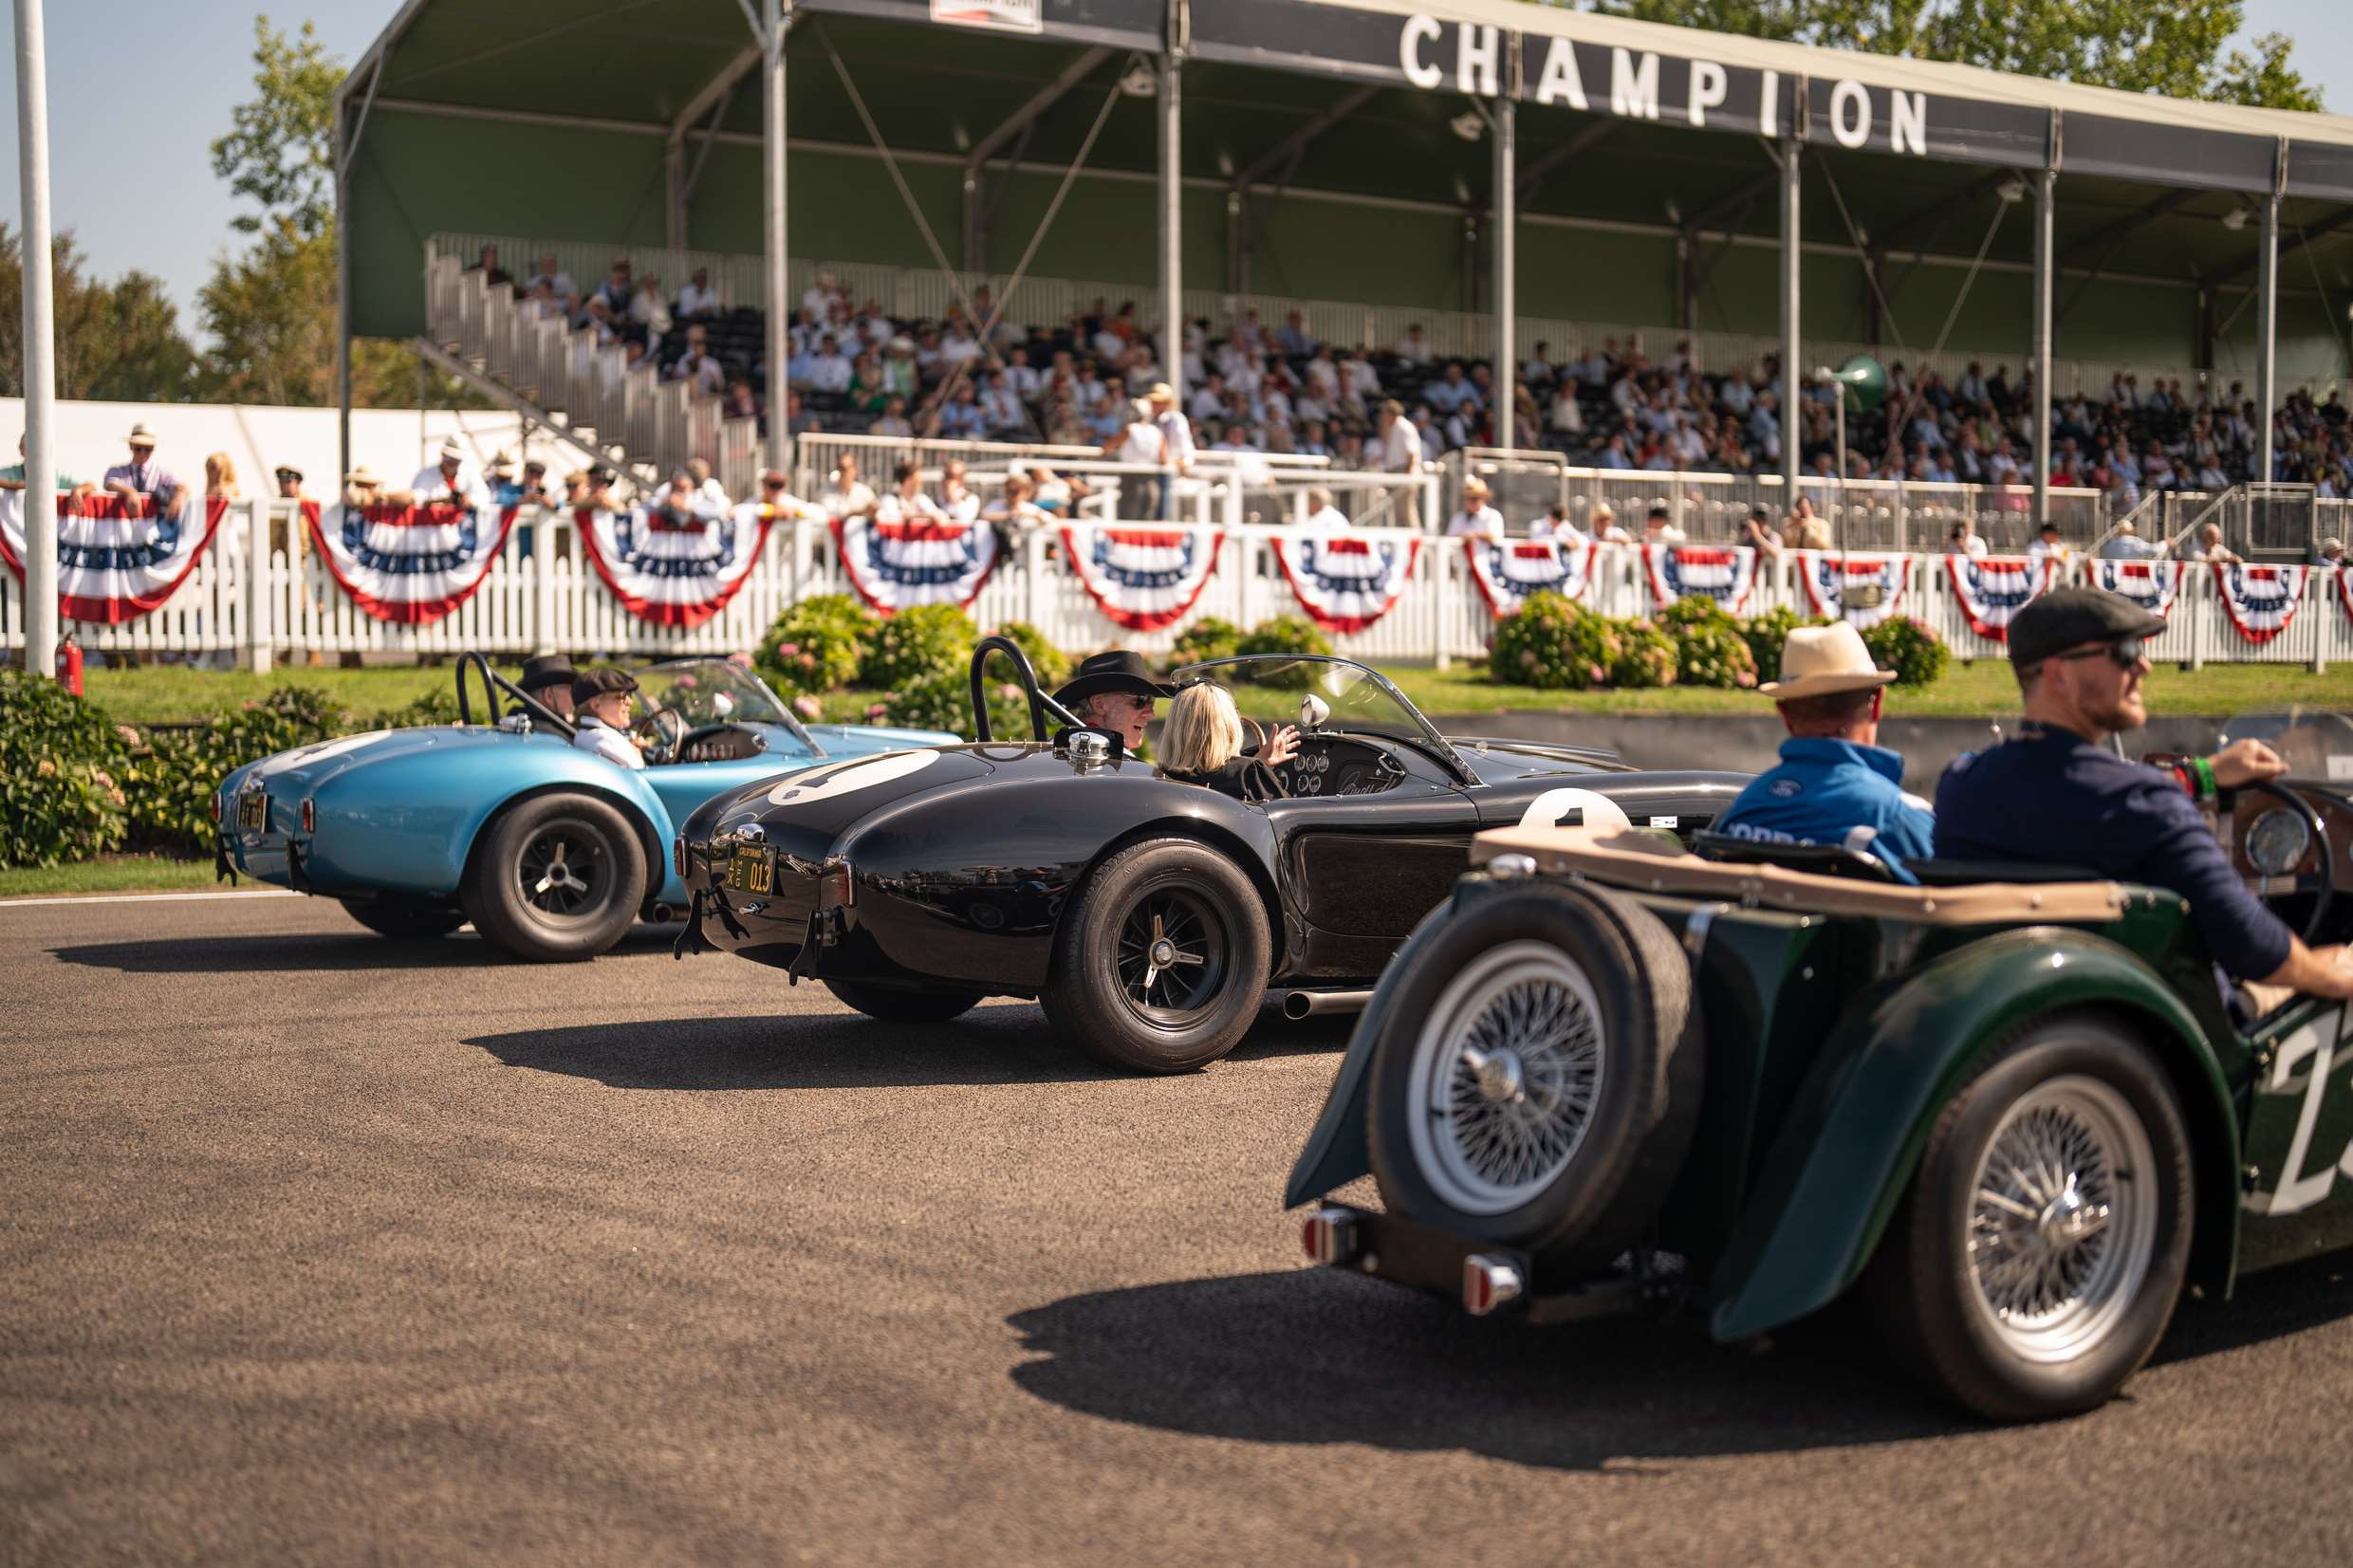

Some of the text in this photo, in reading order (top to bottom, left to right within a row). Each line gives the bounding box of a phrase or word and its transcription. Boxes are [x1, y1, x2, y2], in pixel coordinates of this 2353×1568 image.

[1399, 13, 1927, 156] CHAMPION
[750, 862, 770, 892] 013
[2268, 1001, 2353, 1215] 2
